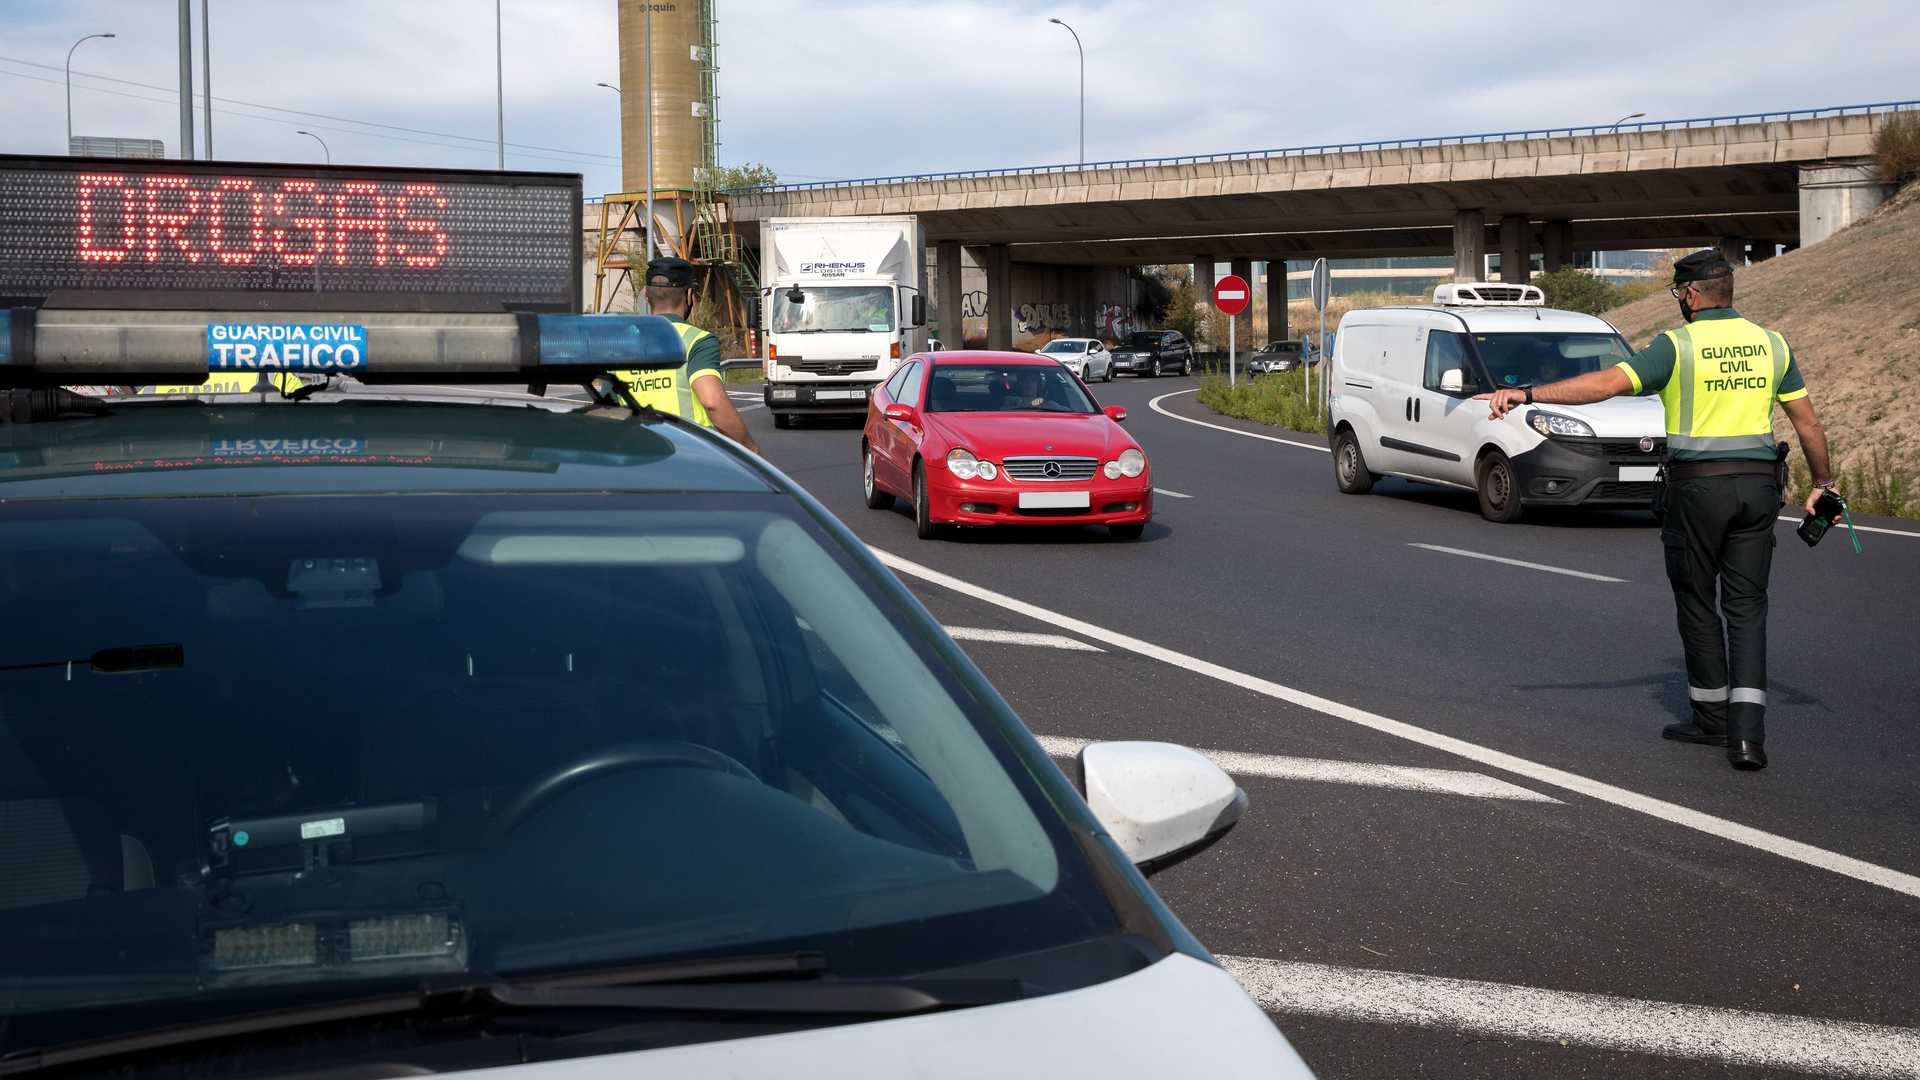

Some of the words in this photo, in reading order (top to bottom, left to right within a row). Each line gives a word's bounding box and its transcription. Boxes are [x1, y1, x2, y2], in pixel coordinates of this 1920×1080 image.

[79, 174, 448, 268] DROGAS
[212, 326, 306, 341] GUARDIA
[310, 326, 361, 341] CIVIL
[1701, 345, 1767, 359] GUARDIA
[1720, 360, 1753, 373] CIVIL
[628, 377, 672, 392] RÁFICO
[1704, 376, 1767, 391] TRÁFICO
